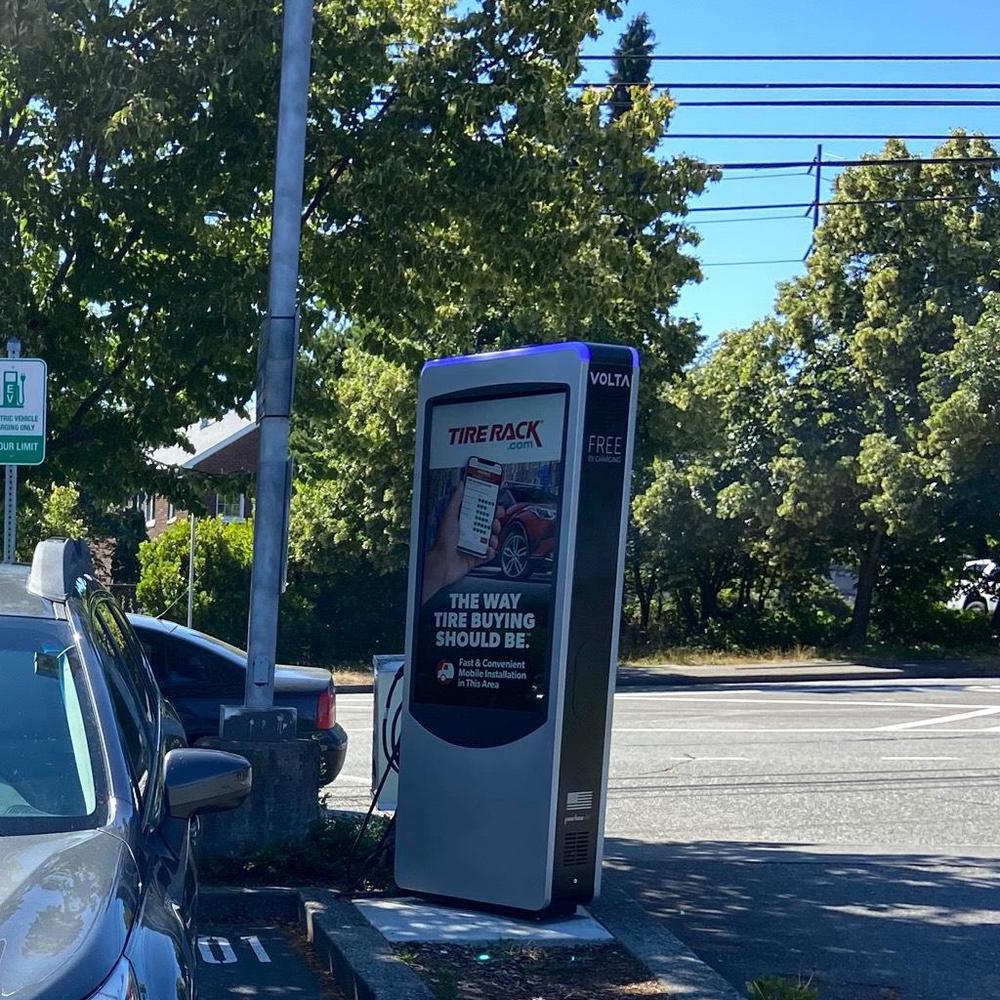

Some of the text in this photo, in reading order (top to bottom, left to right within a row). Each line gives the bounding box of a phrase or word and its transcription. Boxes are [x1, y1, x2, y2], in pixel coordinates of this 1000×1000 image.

[590, 371, 630, 388] VOLTA
[16, 442, 39, 452] LIMIT
[588, 435, 622, 455] FREE
[449, 593, 521, 609] THE WAY
[434, 612, 536, 630] TIRE BUYING
[435, 631, 501, 648] SHOULD
[458, 658, 526, 669] Fast & Convenient
[458, 668, 527, 680] Mobile Installation
[465, 679, 481, 688] This
[481, 680, 500, 689] Area
